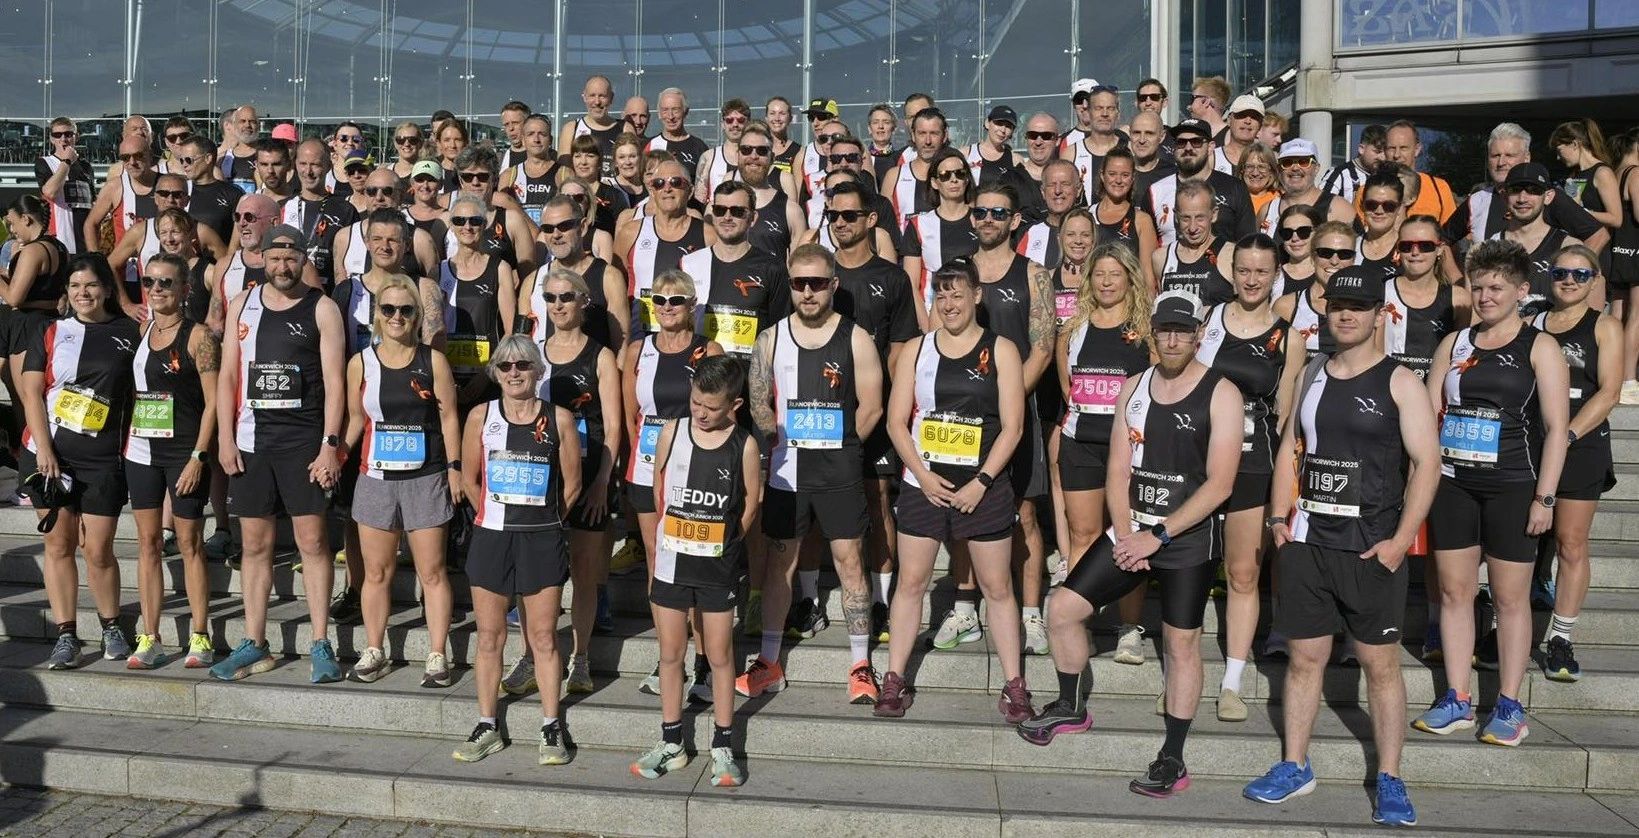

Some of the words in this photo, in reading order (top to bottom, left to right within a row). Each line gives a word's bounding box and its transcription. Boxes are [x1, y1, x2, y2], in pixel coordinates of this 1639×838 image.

[527, 183, 551, 193] GLEN
[255, 374, 291, 391] 452
[1073, 379, 1121, 396] 7503
[793, 413, 835, 430] 2413
[1483, 411, 1500, 419] 2025
[924, 424, 976, 446] 6078
[1444, 420, 1496, 442] 3659
[533, 455, 549, 463] 2025
[491, 465, 546, 486] 2955
[1309, 470, 1348, 493] 1197
[672, 485, 729, 509] TEDDY
[1138, 483, 1170, 506] 182
[1312, 493, 1337, 503] MARTIN
[675, 520, 711, 541] 109
